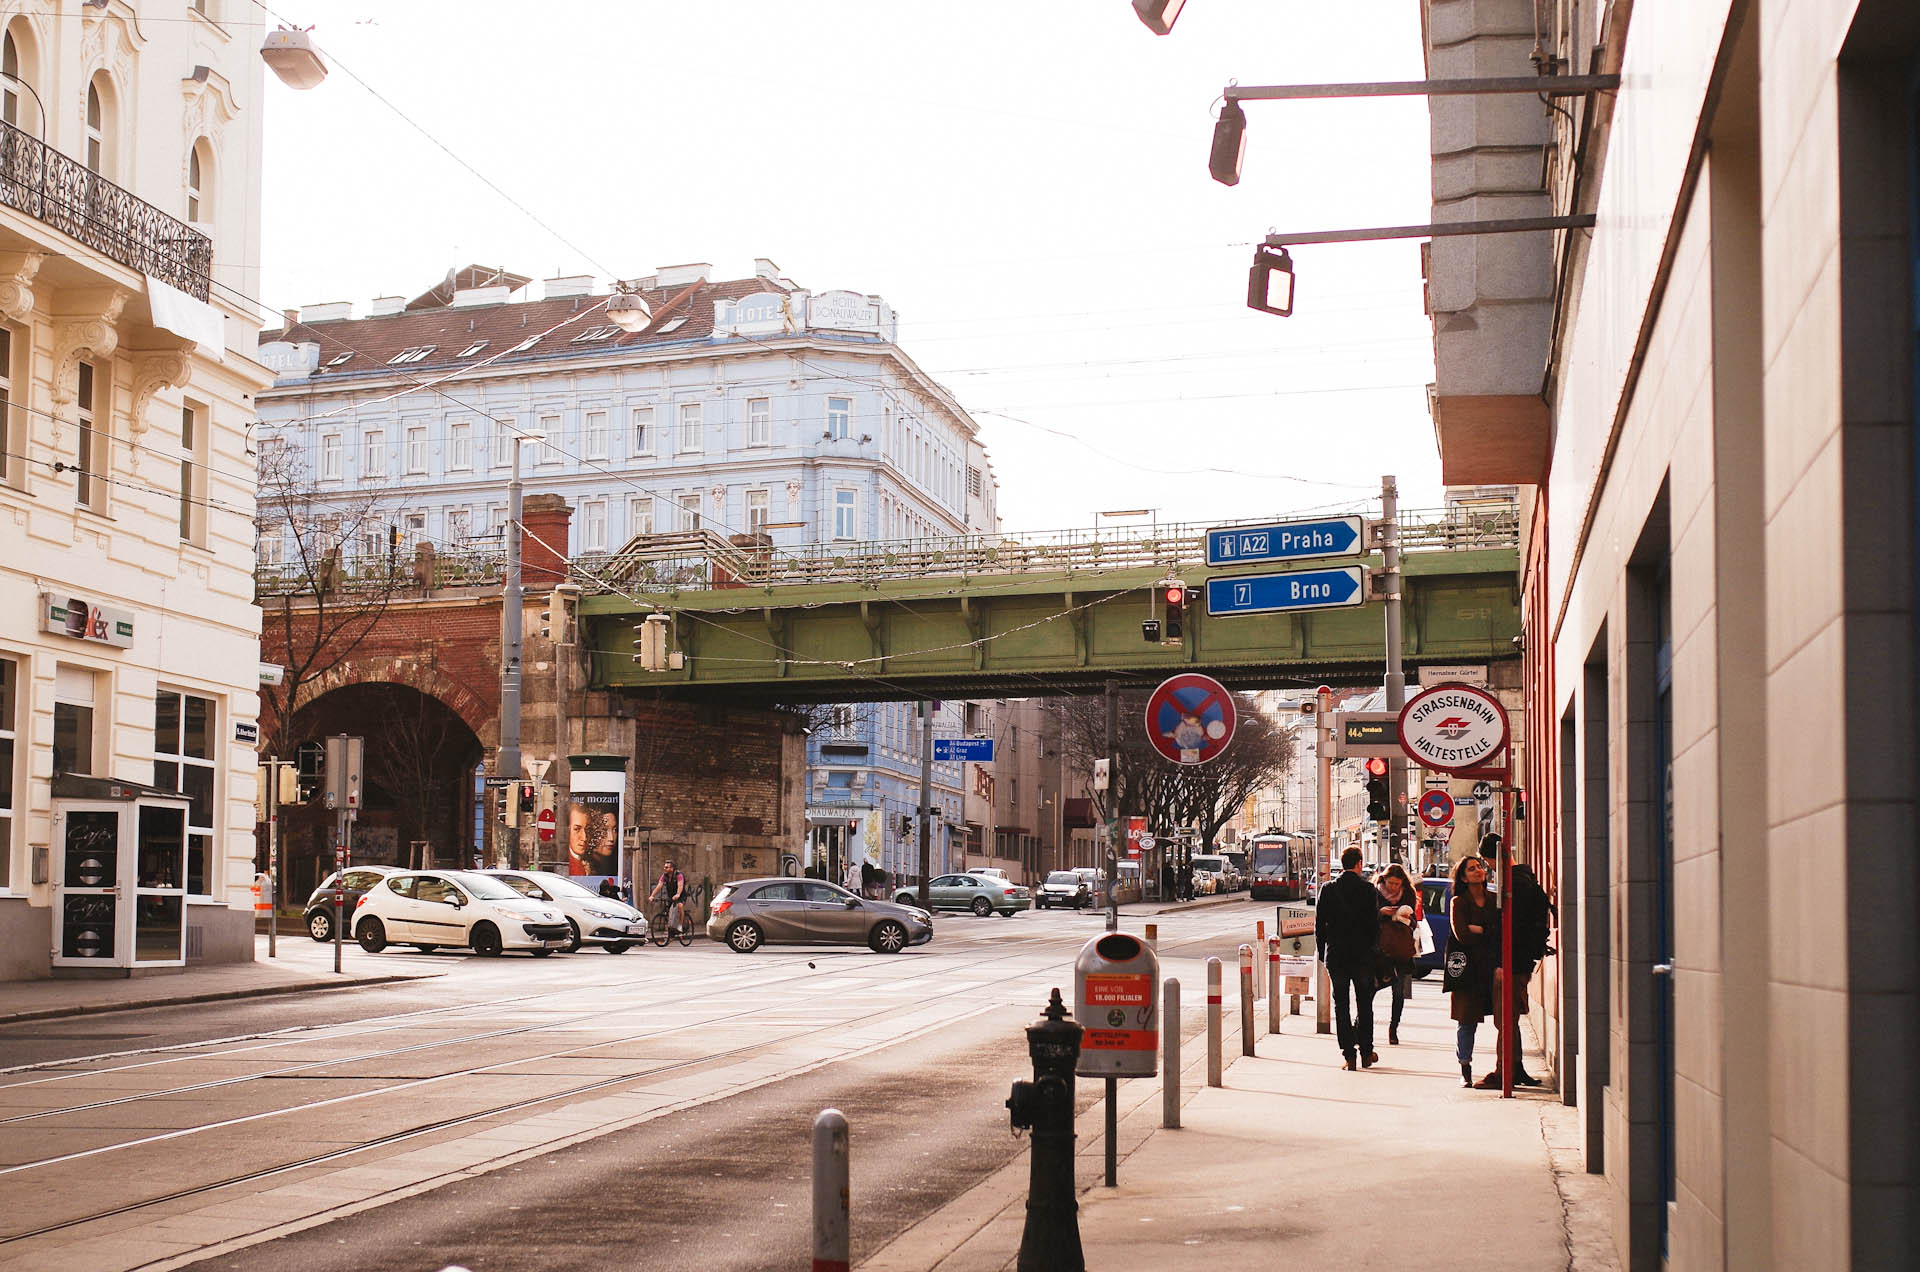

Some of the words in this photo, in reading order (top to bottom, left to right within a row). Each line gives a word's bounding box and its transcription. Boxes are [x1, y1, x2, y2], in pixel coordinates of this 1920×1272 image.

[736, 303, 785, 322] HOTEL
[816, 306, 873, 321] DONAUWALZER
[1242, 536, 1267, 553] A22
[1281, 530, 1333, 550] Praha
[1239, 587, 1247, 602] 7
[1290, 581, 1331, 600] Brno
[1412, 696, 1496, 725] STRASSENBAHN
[1348, 727, 1357, 738] 44
[1414, 736, 1491, 761] HALTESTELLE
[1473, 785, 1491, 797] 44
[1288, 910, 1308, 918] Hier
[1094, 985, 1109, 993] EINE
[1111, 985, 1124, 993] VON
